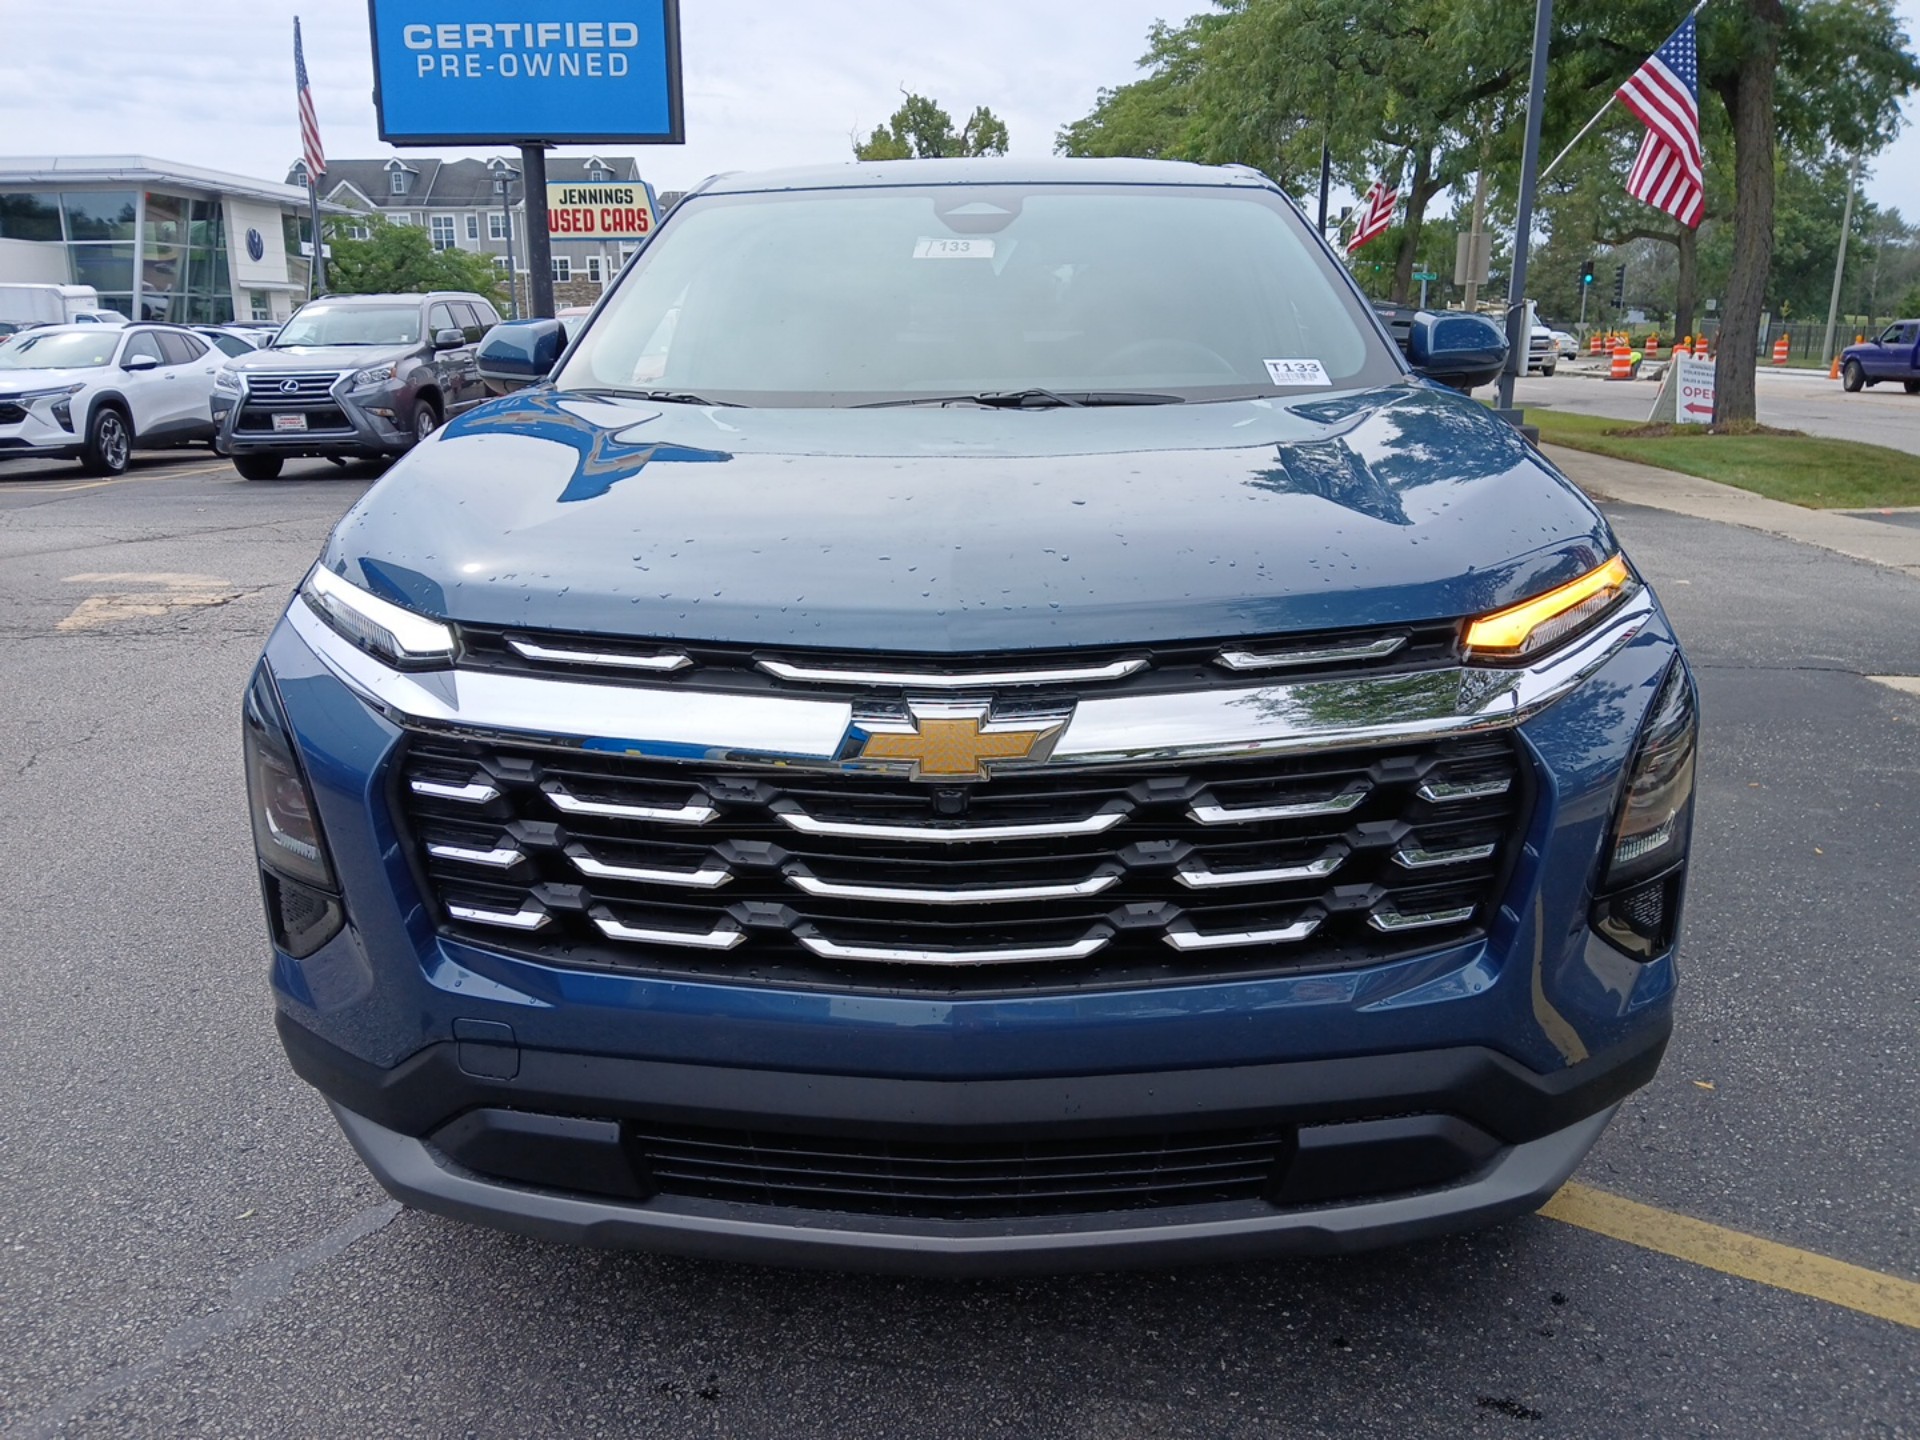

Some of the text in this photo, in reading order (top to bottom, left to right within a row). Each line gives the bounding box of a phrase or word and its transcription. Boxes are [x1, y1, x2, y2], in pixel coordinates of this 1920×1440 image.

[403, 22, 639, 50] CERTIFIED
[417, 53, 628, 78] PRE-OWNED
[559, 188, 634, 205] JENNINGS
[548, 208, 649, 233] USED CARS
[1268, 362, 1320, 373] T133
[1683, 369, 1715, 378] VOLKSWAG
